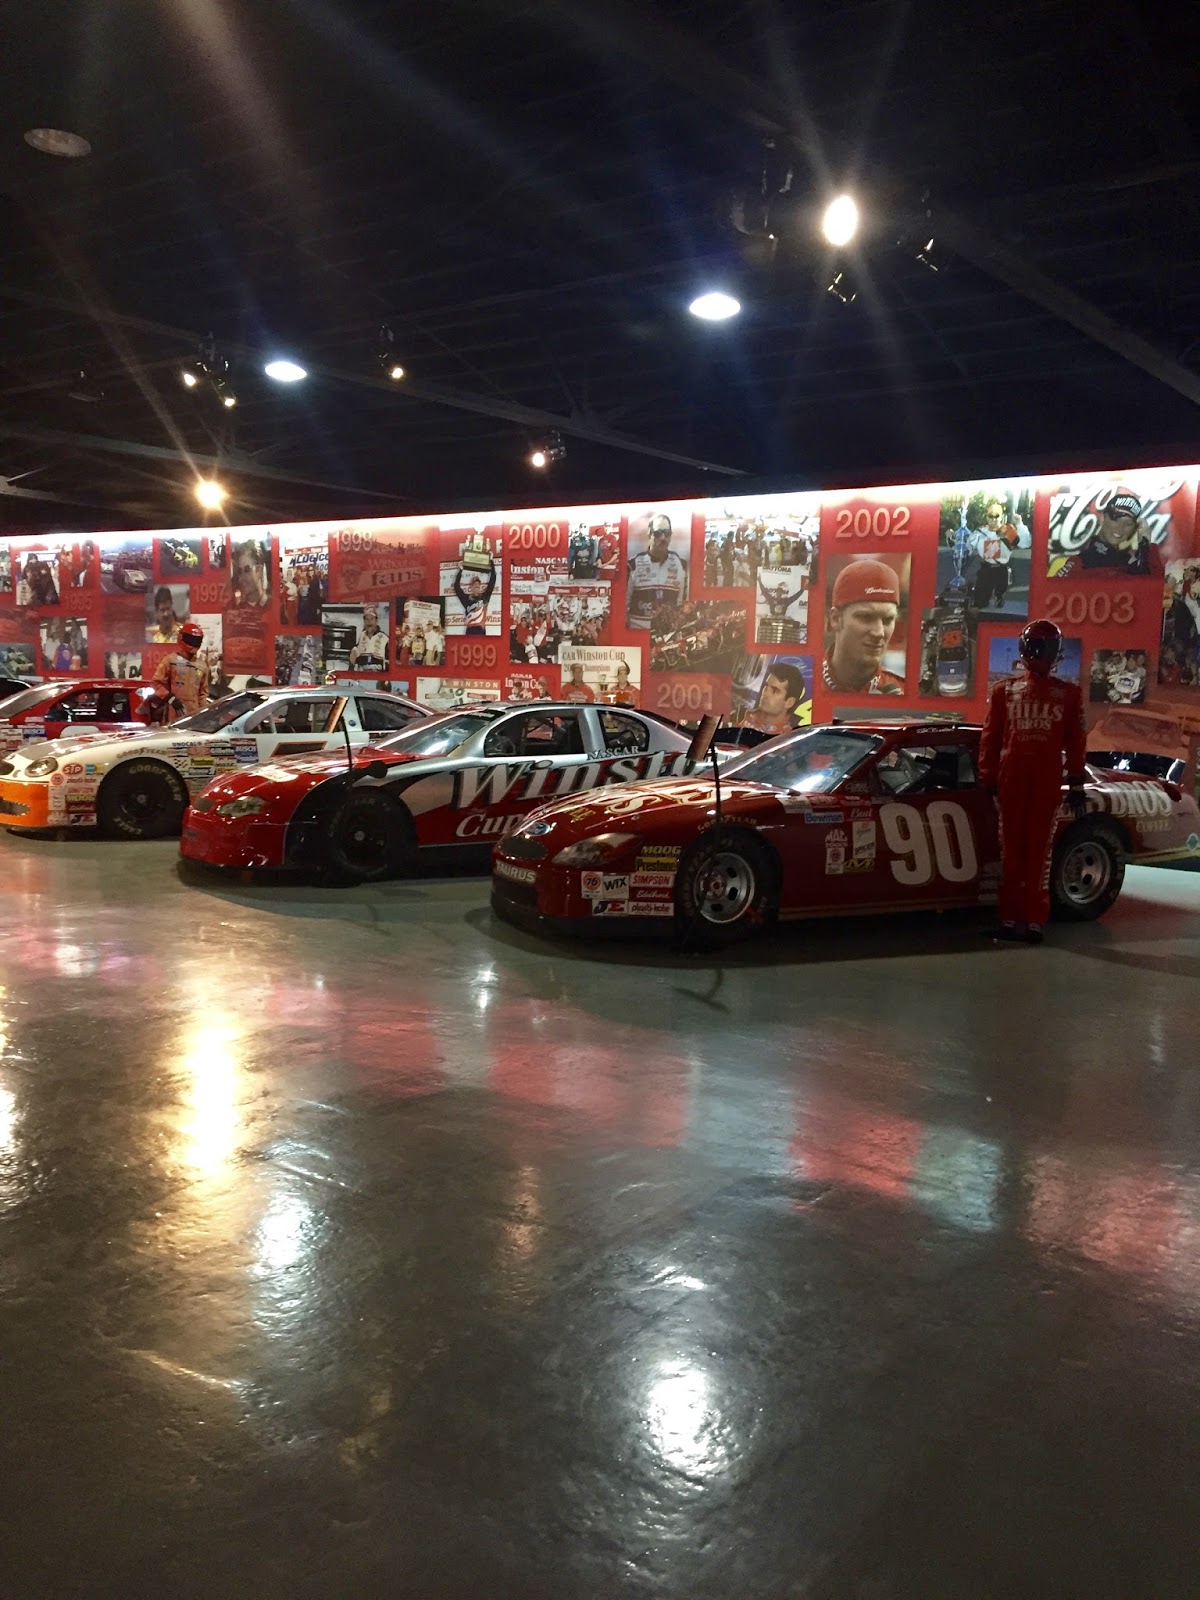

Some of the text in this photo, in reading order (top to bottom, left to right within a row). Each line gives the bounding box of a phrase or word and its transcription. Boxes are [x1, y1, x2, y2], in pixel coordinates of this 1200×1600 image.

[836, 506, 911, 538] 2002
[332, 530, 374, 552] 1998
[508, 523, 561, 549] 2000
[371, 570, 423, 586] fans
[193, 583, 226, 602] 1997
[1045, 591, 1135, 624] 2003
[451, 643, 497, 667] 1999
[577, 649, 608, 661] Winston
[657, 682, 713, 710] 2001
[1006, 703, 1064, 721] HILLS
[1017, 719, 1051, 731] BROS
[587, 745, 640, 760] NASCAR
[64, 765, 82, 775] STP
[452, 750, 698, 810] Winsto
[806, 813, 842, 822] Bowman
[851, 808, 872, 818] Bud
[456, 813, 524, 838] Cup
[641, 846, 681, 854] MOOG
[879, 800, 978, 886] 90
[637, 860, 677, 872] Prestone
[587, 877, 598, 886] 76
[604, 878, 627, 890] WIX
[632, 874, 671, 885] SIMPSON
